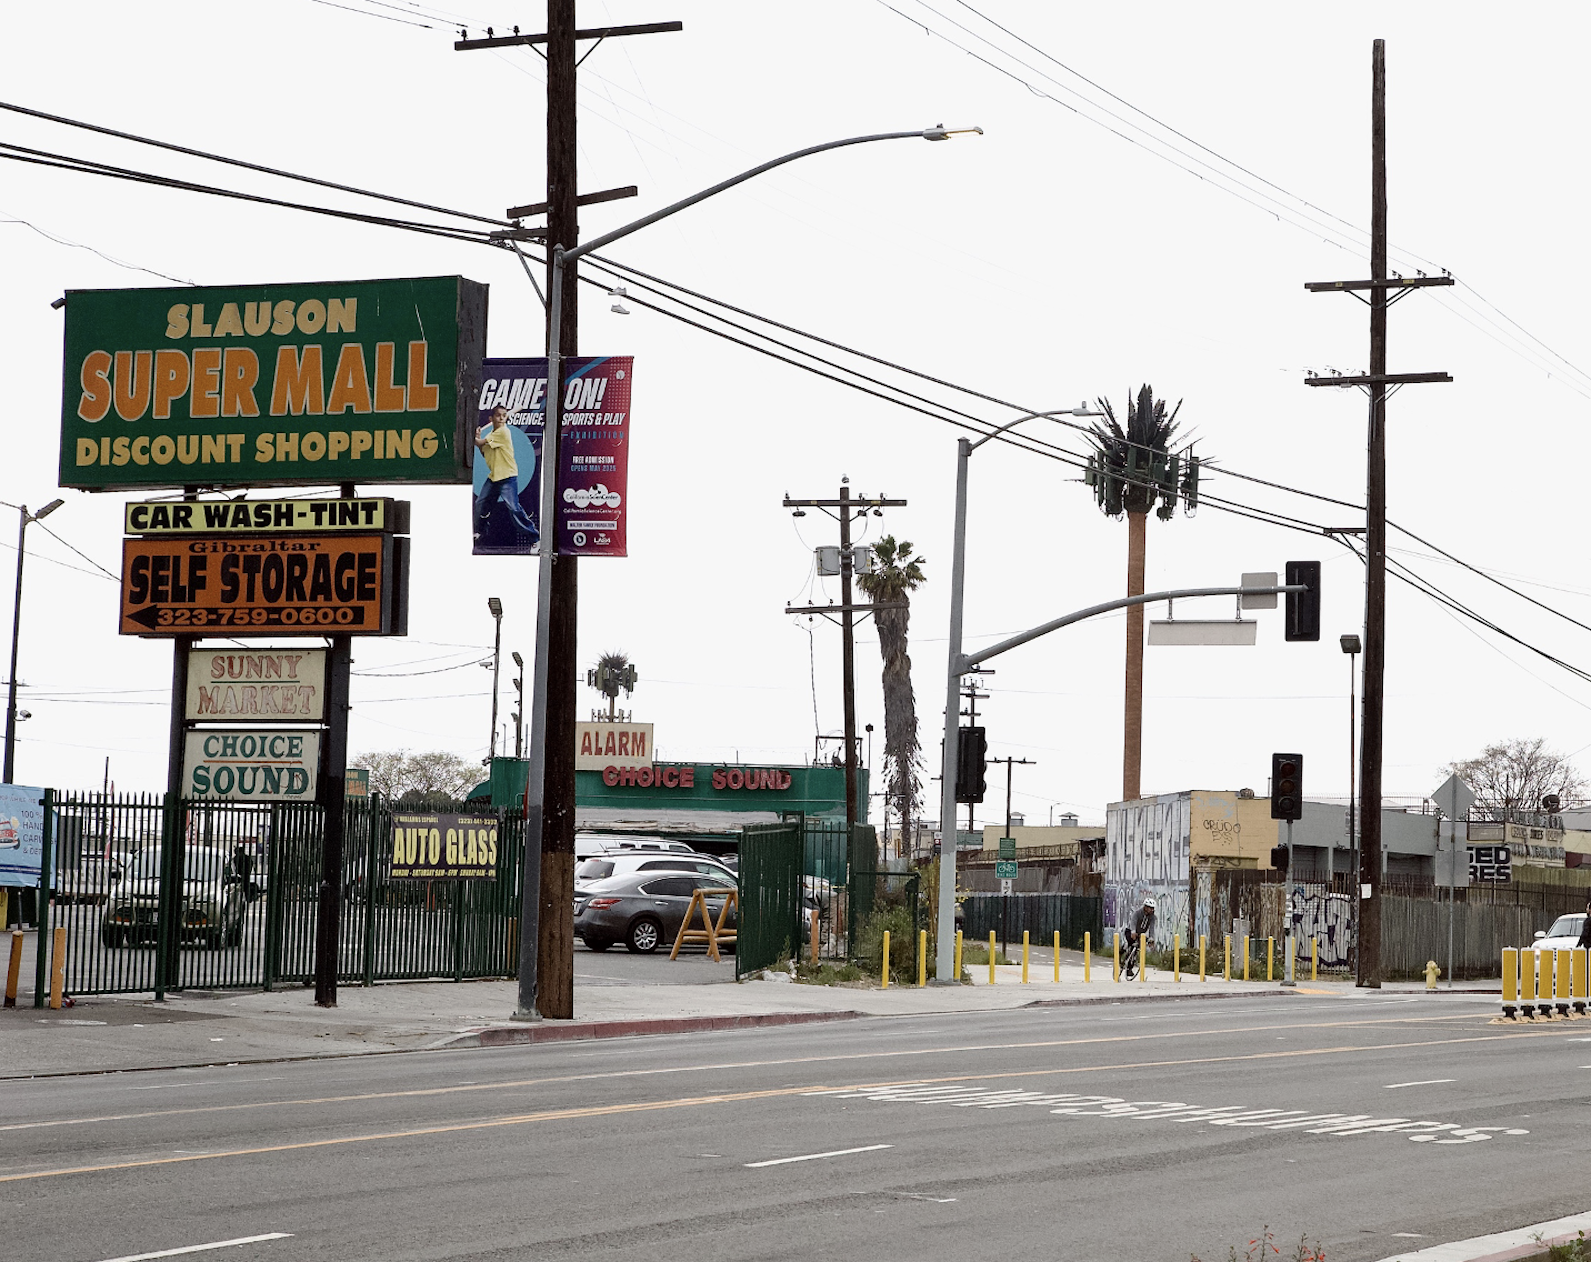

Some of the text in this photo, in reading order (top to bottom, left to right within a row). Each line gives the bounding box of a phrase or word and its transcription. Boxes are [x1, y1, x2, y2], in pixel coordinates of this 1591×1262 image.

[165, 298, 357, 340] SLAUSON
[77, 340, 440, 423] SUPER MALL
[478, 377, 608, 411] GAME ON!
[562, 412, 594, 426] SPORTS
[593, 412, 602, 426] &
[602, 412, 626, 426] PLAY
[75, 428, 438, 468] DISCOUNT SHOPPING
[570, 430, 624, 440] EXHIBITION
[130, 505, 193, 531] CAR
[188, 539, 321, 555] Gibraltar
[128, 551, 376, 606] SELF STORAGE
[156, 607, 354, 626] 323-759-0600
[210, 655, 303, 679] SUNNY
[197, 685, 316, 715] MARKET
[203, 735, 303, 758] CHOICE
[580, 731, 646, 758] ALARM
[192, 765, 309, 795] SOUND
[602, 765, 792, 790] CHOICE SOUND
[392, 828, 498, 866] AUTO GLASS
